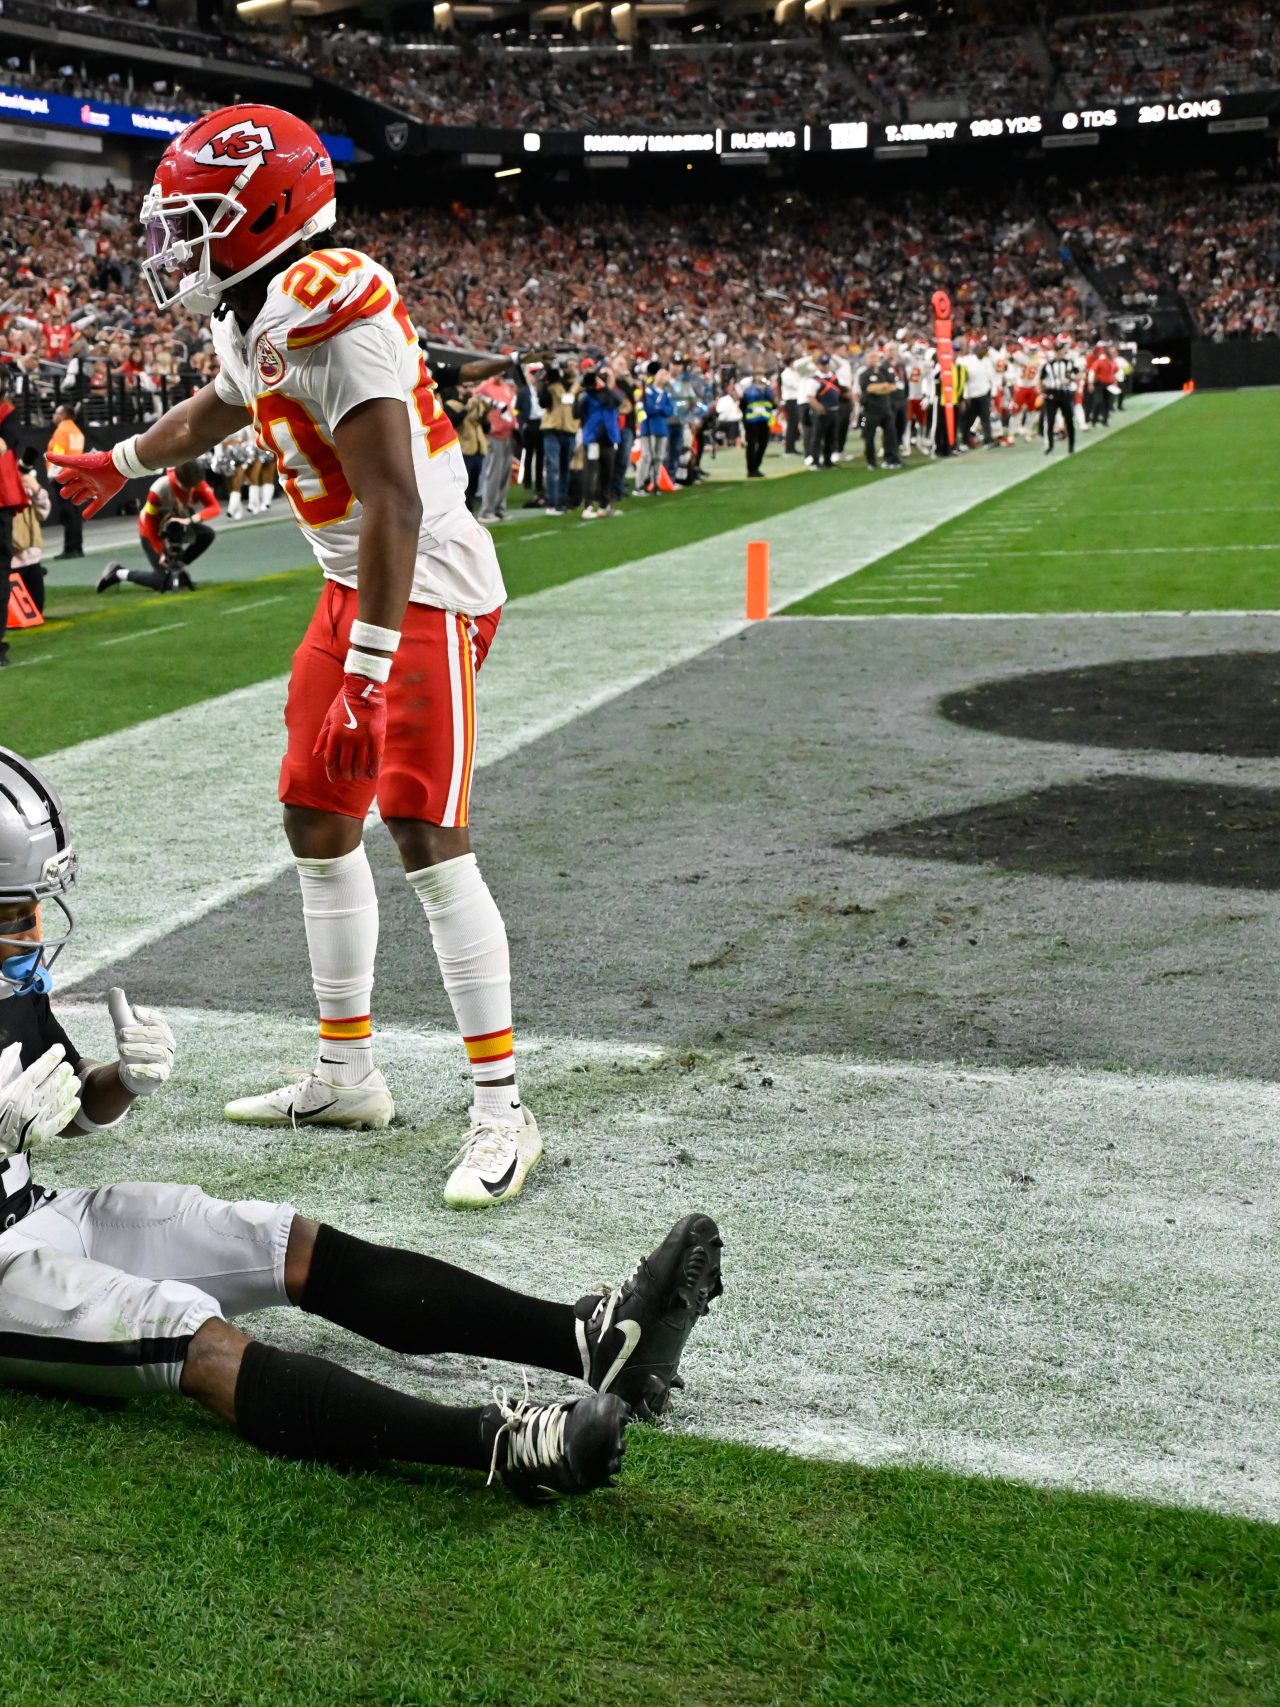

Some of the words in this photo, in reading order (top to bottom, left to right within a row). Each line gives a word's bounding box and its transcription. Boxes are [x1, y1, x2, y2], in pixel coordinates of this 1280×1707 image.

[1004, 116, 1042, 134] YDS
[1081, 109, 1117, 128] TDS
[1167, 99, 1221, 119] LONG
[209, 131, 262, 159] KC
[731, 131, 795, 149] RUSHING
[281, 248, 364, 311] 20
